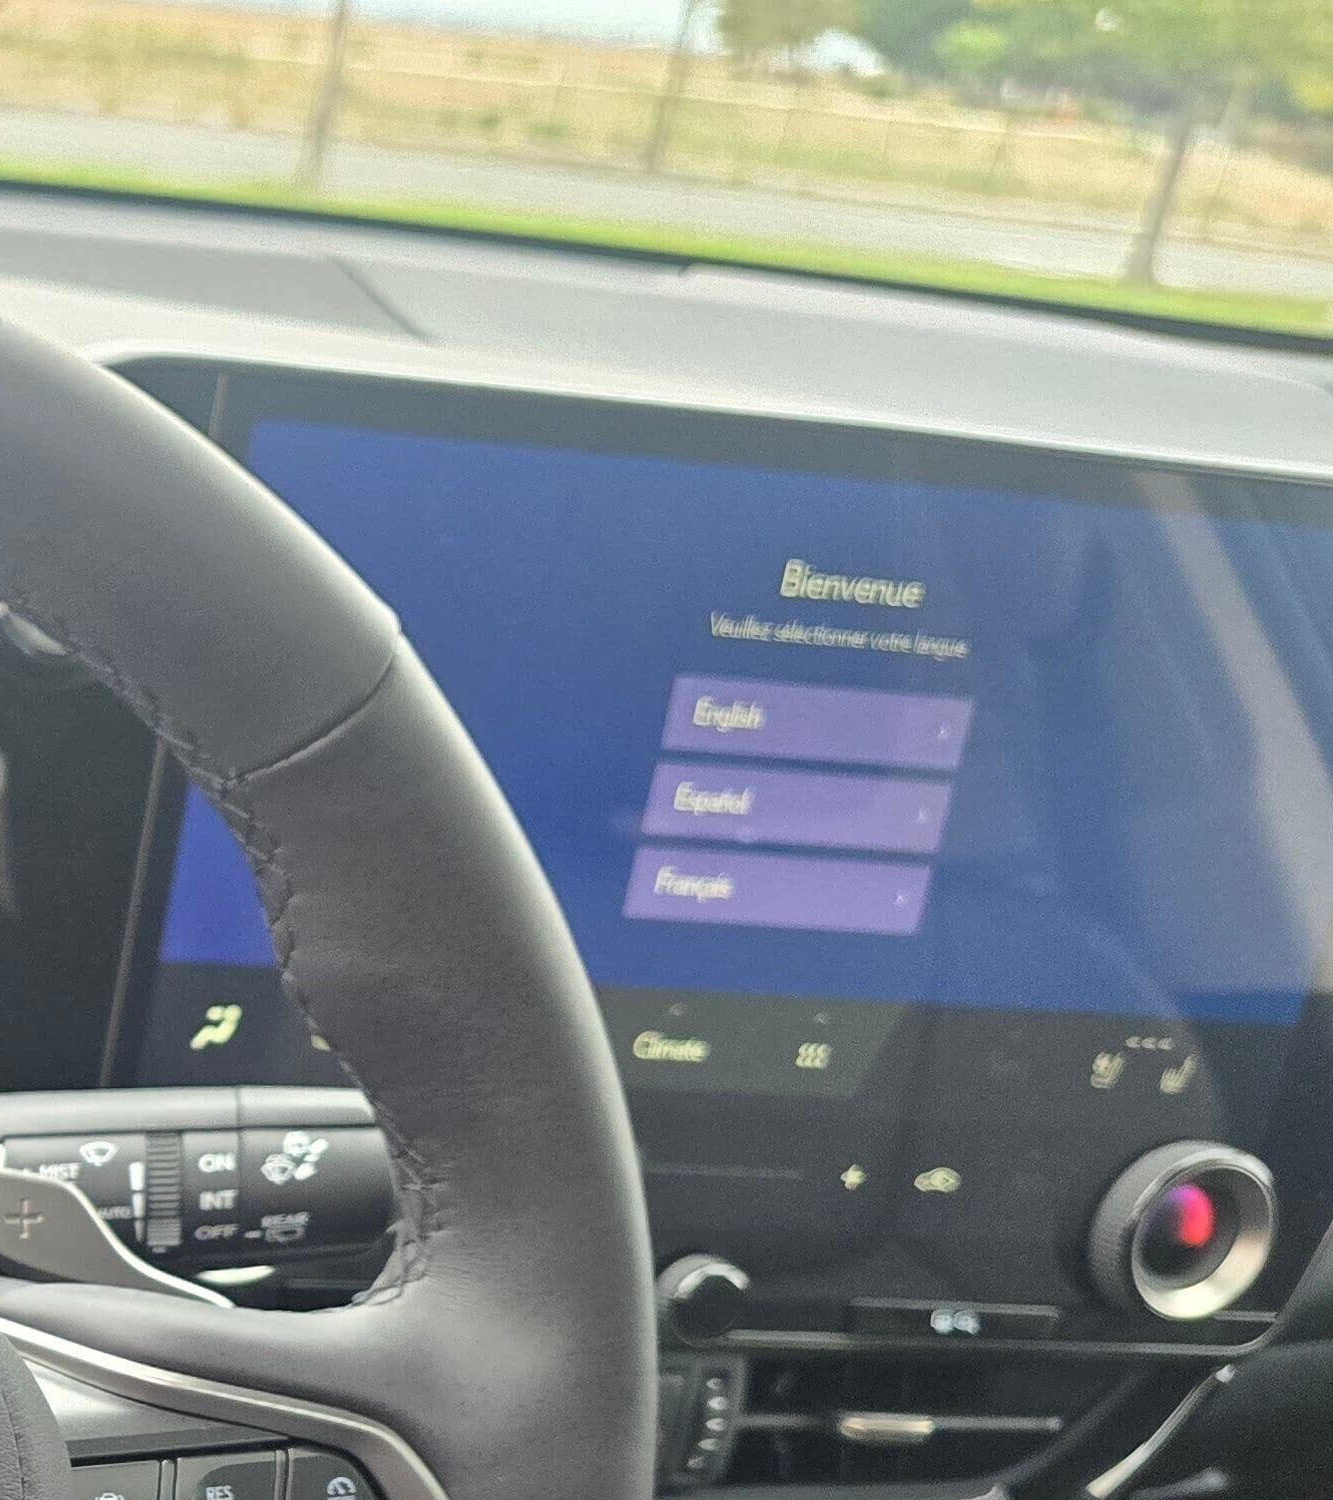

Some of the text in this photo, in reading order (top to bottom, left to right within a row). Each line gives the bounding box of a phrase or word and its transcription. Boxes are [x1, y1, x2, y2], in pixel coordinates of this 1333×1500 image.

[780, 559, 928, 608] Bienvenue
[711, 611, 773, 641] Veuillez
[693, 695, 765, 732] English
[673, 781, 753, 816] Español
[654, 865, 734, 902] Français
[633, 1031, 709, 1062] Climate
[198, 1153, 236, 1173] ON
[199, 1190, 238, 1210] INT
[194, 1223, 238, 1240] OFF
